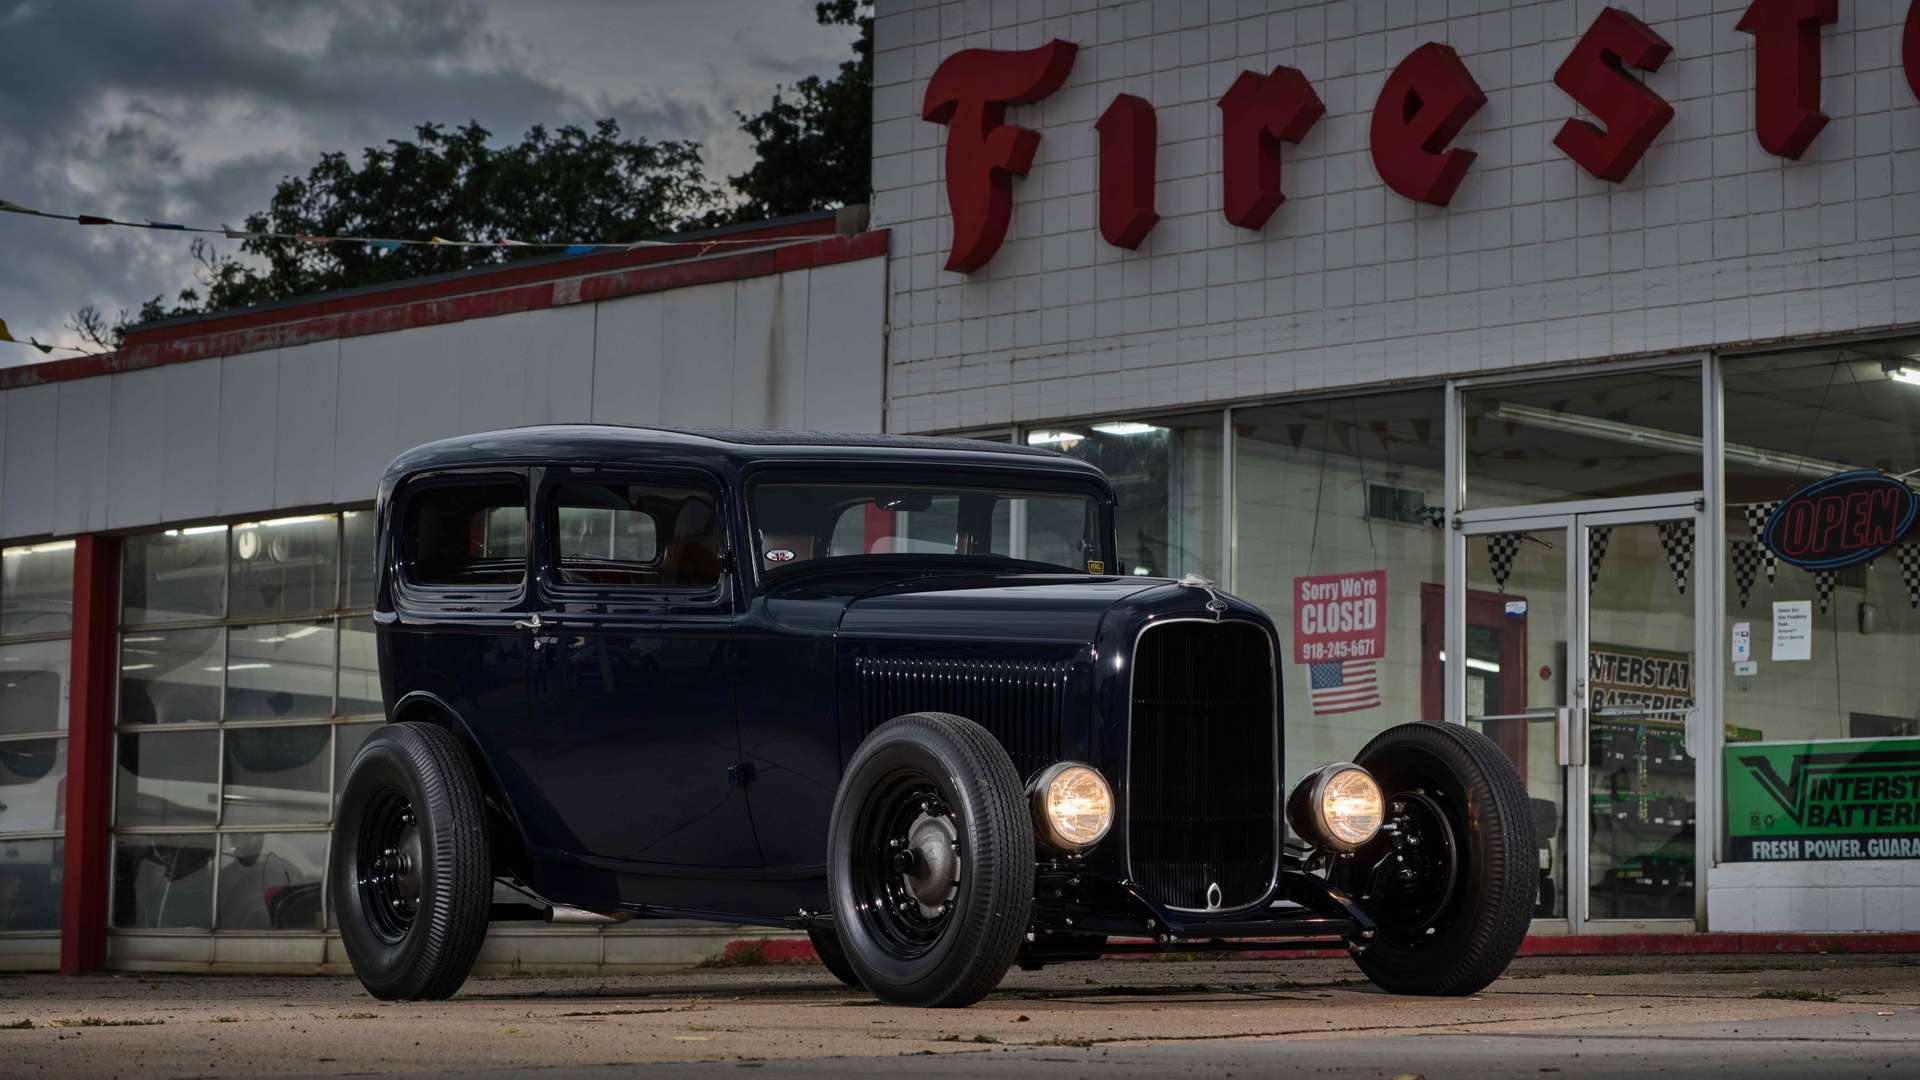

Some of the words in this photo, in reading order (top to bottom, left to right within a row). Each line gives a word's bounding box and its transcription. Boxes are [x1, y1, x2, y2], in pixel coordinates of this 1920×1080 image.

[922, 0, 1920, 272] Firest
[1783, 487, 1900, 556] OPEN
[1302, 581, 1339, 601] Sorry
[1340, 577, 1377, 597] We're
[1301, 598, 1377, 635] CLOSED
[1303, 638, 1376, 660] 918-245-6671
[1752, 840, 1800, 860] FRESH
[1804, 839, 1867, 859] POWER.
